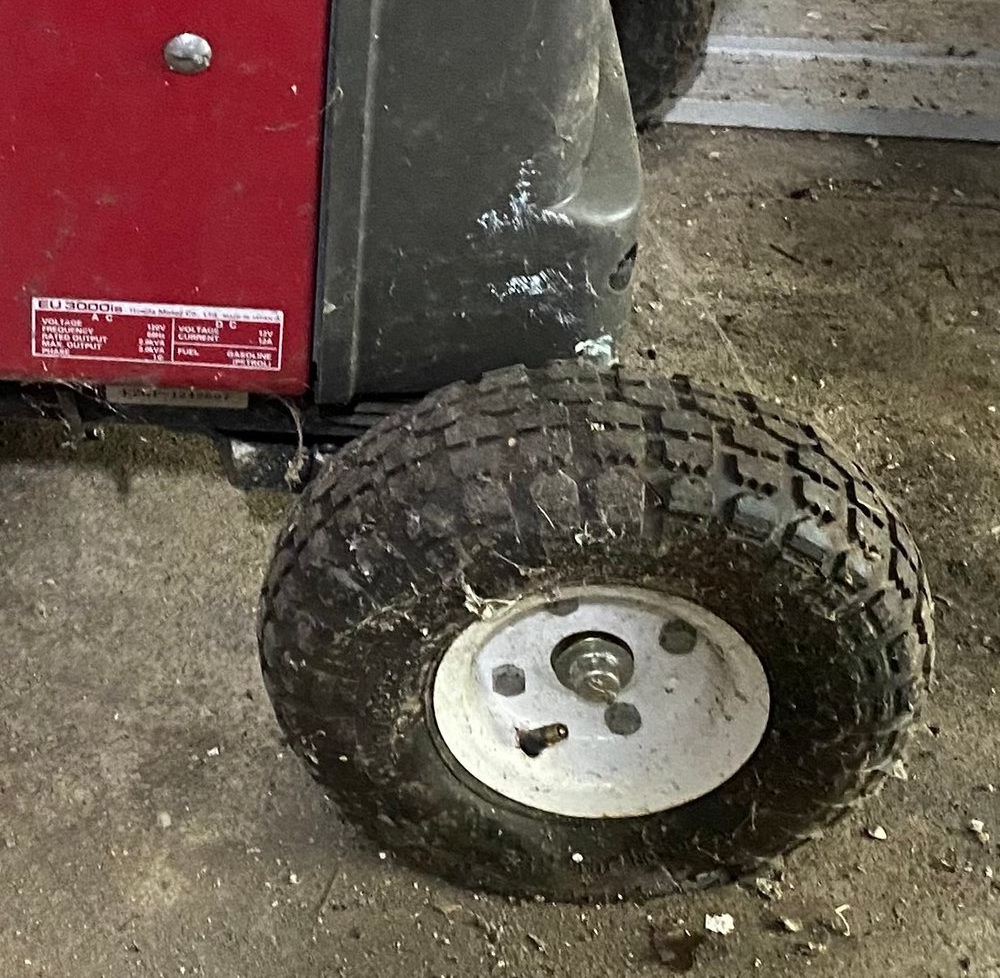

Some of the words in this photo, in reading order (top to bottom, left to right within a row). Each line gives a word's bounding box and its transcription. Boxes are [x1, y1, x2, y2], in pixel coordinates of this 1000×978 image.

[38, 300, 61, 310] EU
[65, 302, 123, 313] 3000is
[91, 313, 99, 322] A
[105, 314, 113, 322] C
[41, 318, 83, 327] VOLTAGE
[215, 320, 223, 329] D
[229, 320, 237, 329] C
[41, 325, 94, 335] FREQUENCY
[178, 325, 220, 334] VOLTAGE
[41, 333, 70, 342] RATED
[72, 334, 108, 344] OUTPUT
[178, 333, 220, 342] CURRENT
[67, 341, 102, 351] OUTPUT
[41, 347, 70, 356] PHASE
[177, 347, 200, 356] FUEL
[226, 350, 272, 360] GASOLINE
[232, 358, 272, 368] (PETROL)
